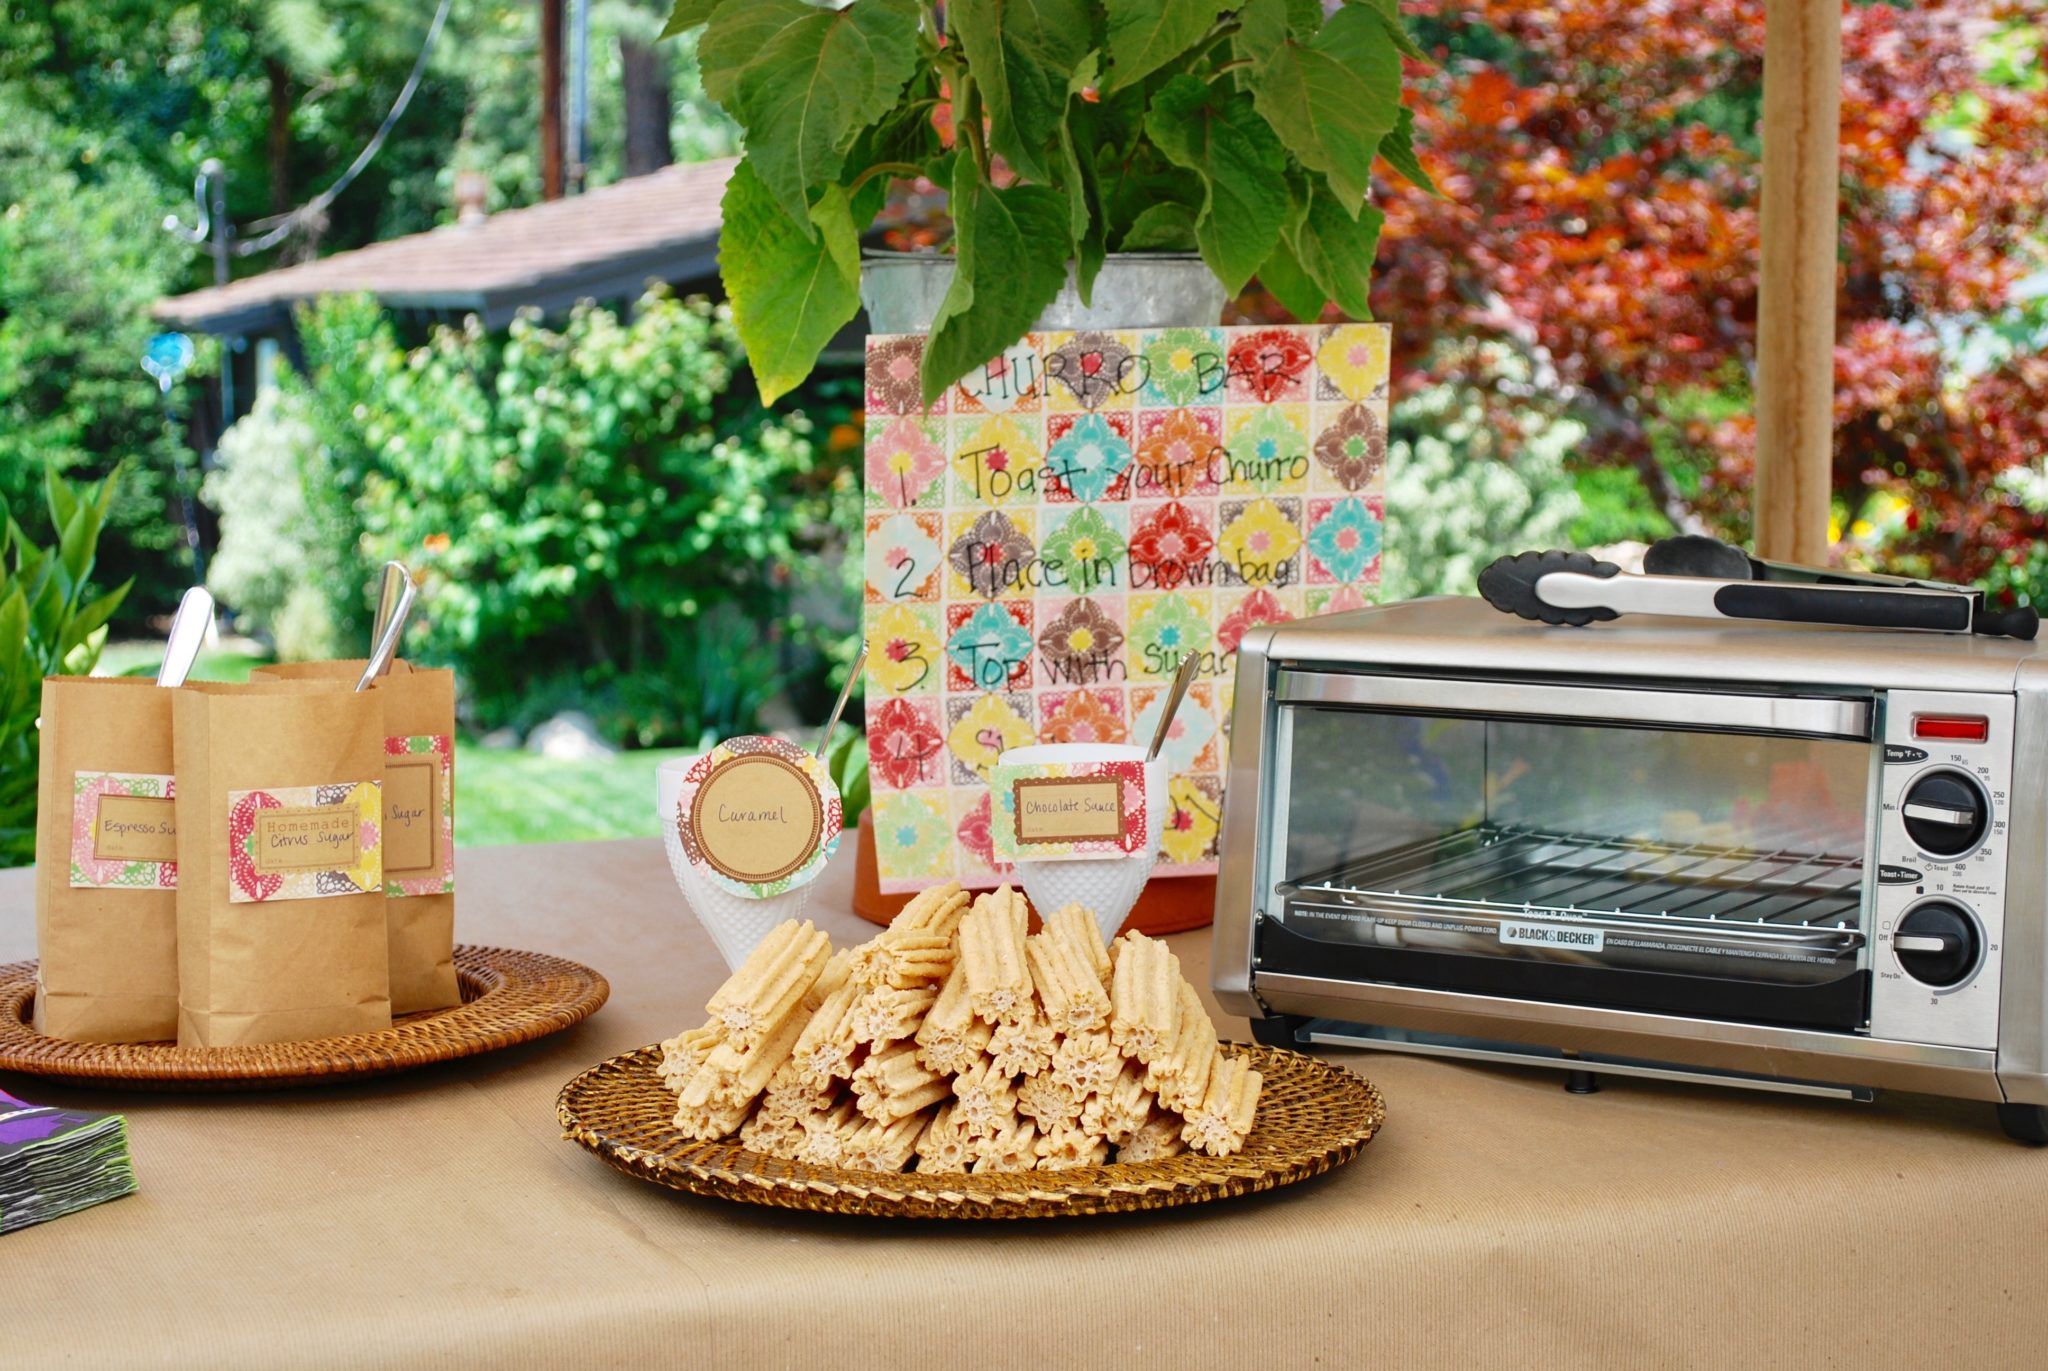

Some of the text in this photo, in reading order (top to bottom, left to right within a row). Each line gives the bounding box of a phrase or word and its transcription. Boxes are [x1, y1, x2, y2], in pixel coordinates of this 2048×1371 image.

[1192, 352, 1301, 395] BAR
[899, 443, 1310, 507] 1. Toast your Churro
[967, 541, 1068, 593] Place
[1081, 547, 1117, 588] in
[1128, 548, 1229, 589] brown
[1238, 548, 1290, 589] bag
[957, 642, 1027, 694] Top
[1040, 648, 1128, 686] with
[1886, 749, 1904, 758] Temp
[1950, 754, 1962, 762] 150
[1026, 797, 1116, 814] Chocolate Sauce
[392, 804, 425, 827] Sugar
[718, 803, 788, 823] Caramel
[104, 820, 155, 838] Espresso
[267, 818, 349, 833] Homemade
[1994, 821, 2006, 829] 300
[271, 831, 354, 849] Citrus Sugar
[1980, 848, 1992, 856] 350
[1901, 855, 1917, 863] Broil
[1954, 863, 1966, 871] 400
[1936, 883, 1944, 891] 10
[1878, 933, 1888, 941] Off
[1990, 943, 1998, 951] 20
[1880, 972, 1893, 980] Stay
